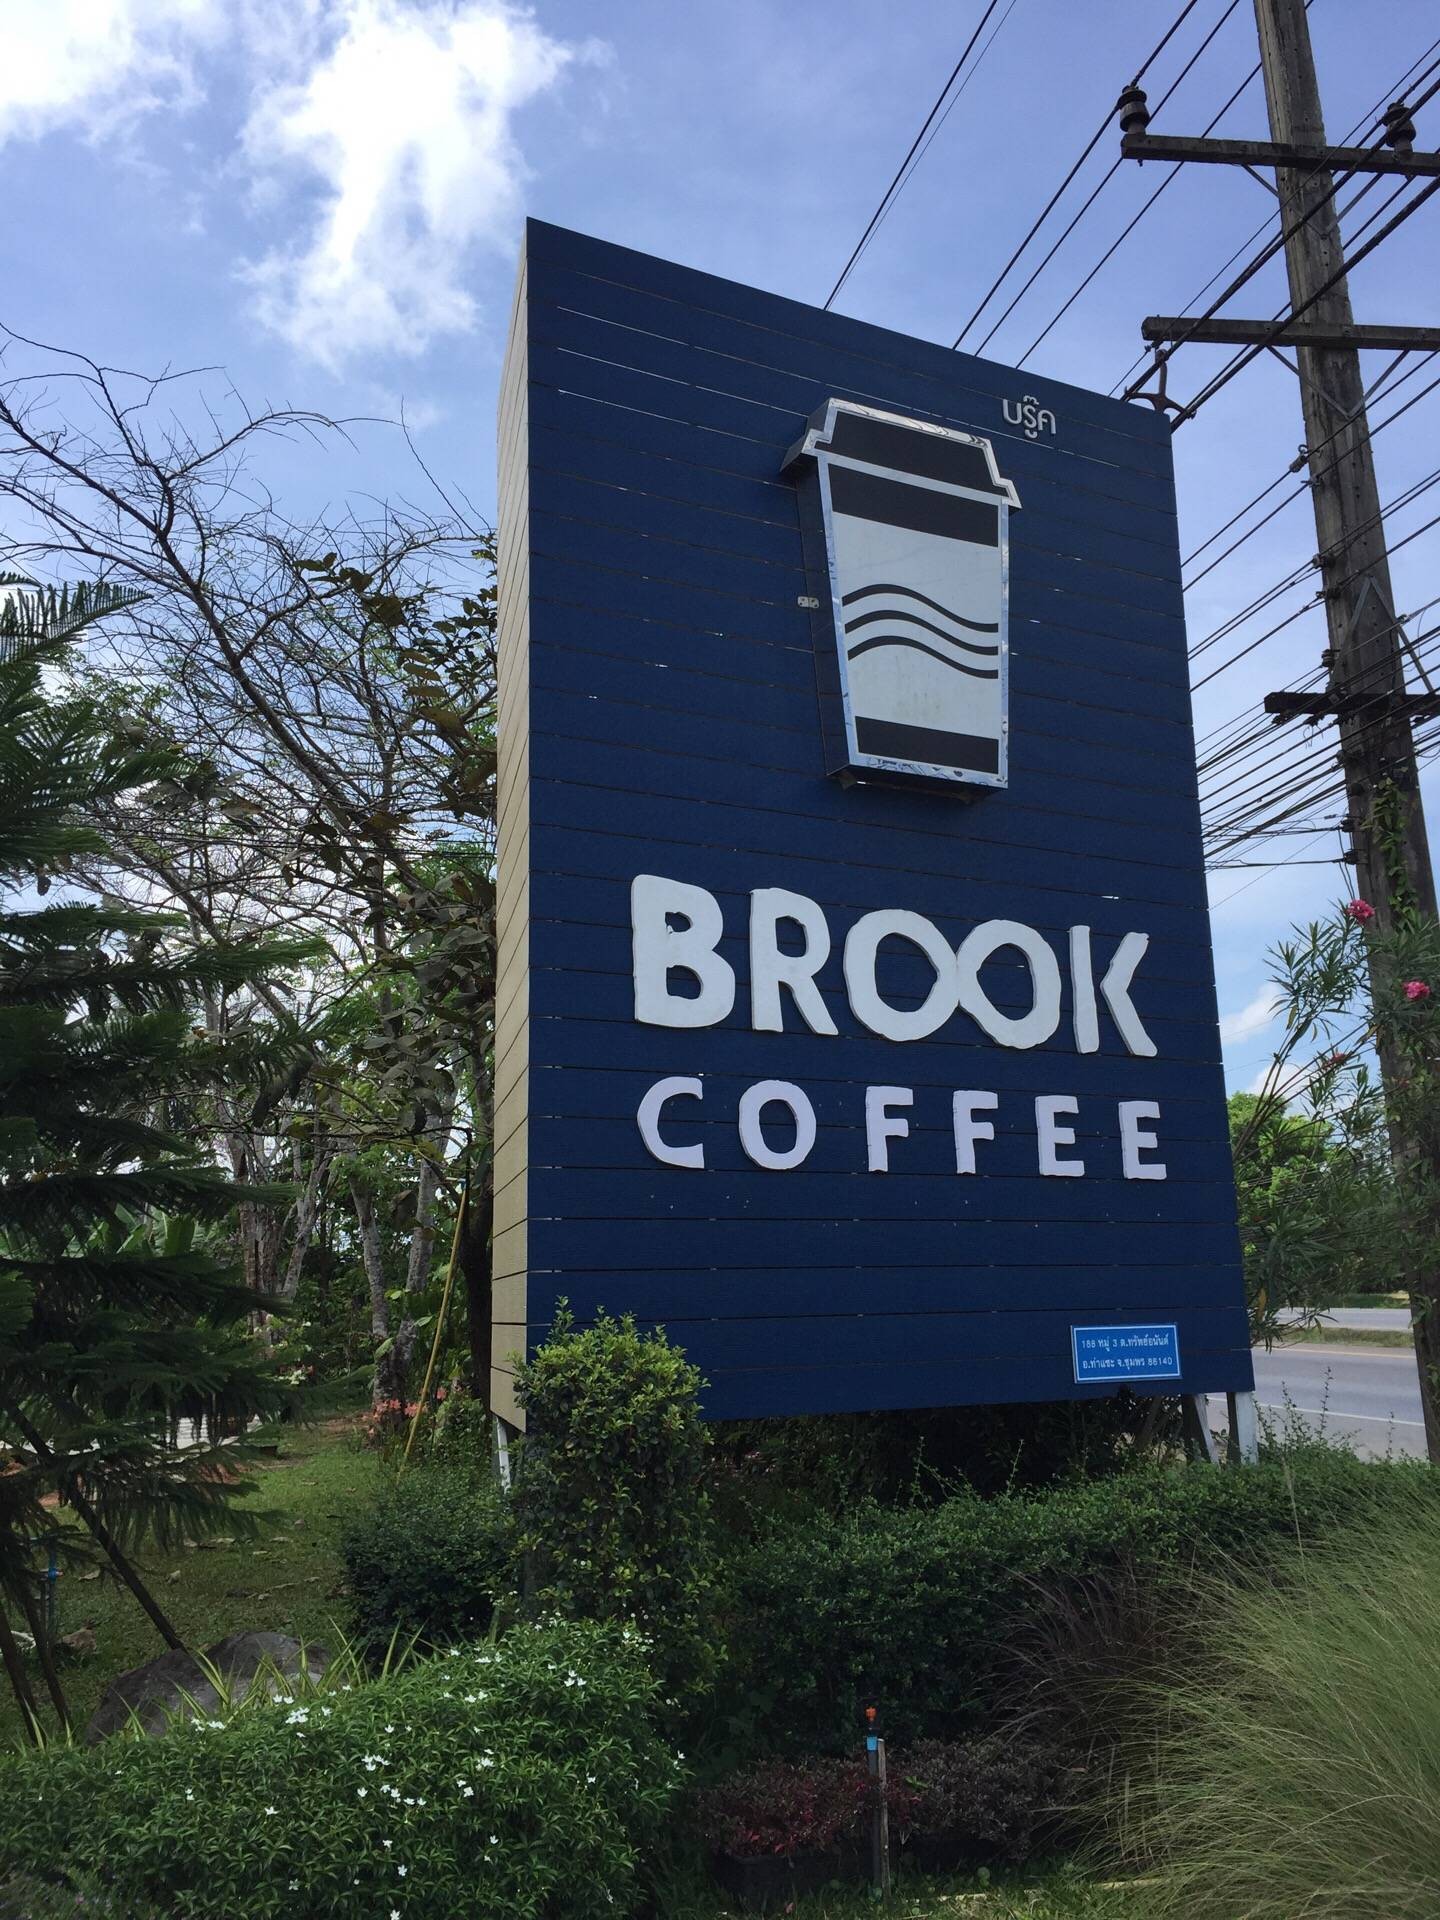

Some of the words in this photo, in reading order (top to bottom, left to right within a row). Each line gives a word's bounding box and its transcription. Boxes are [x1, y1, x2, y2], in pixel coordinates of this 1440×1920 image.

[630, 874, 1158, 1058] BROOK
[636, 1075, 1167, 1181] COFFEE
[1098, 1336, 1111, 1352] หมู่
[1112, 1338, 1118, 1348] 3
